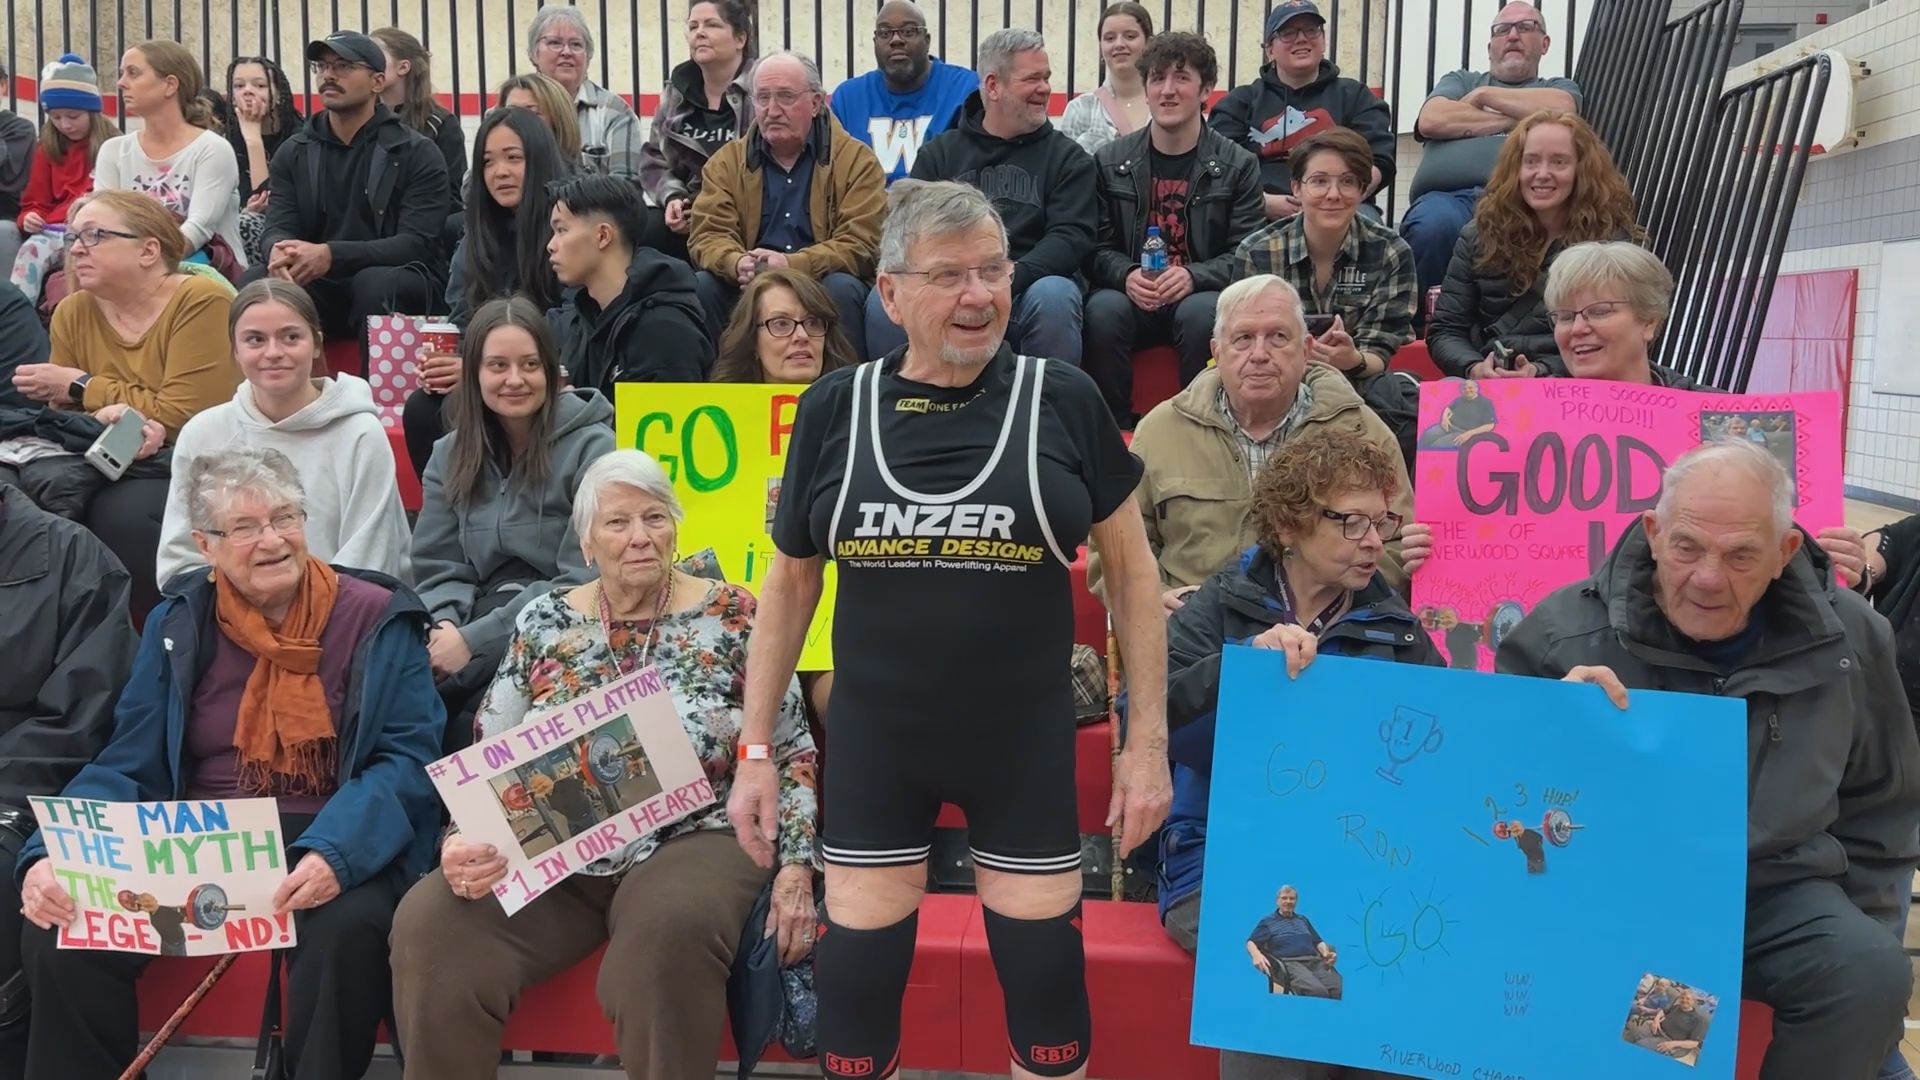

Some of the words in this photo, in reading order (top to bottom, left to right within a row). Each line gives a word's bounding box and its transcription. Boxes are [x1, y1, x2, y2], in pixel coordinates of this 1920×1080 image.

[867, 115, 933, 174] W
[899, 400, 926, 409] TEAM
[929, 402, 950, 412] ONE
[1543, 381, 1591, 399] WE'RE
[1561, 401, 1653, 430] PROUD!!!
[635, 404, 738, 493] GO
[1457, 431, 1667, 516] GOOD
[854, 502, 1016, 540] INZER
[1509, 522, 1537, 540] OF
[837, 538, 932, 557] ADVANCE
[940, 539, 1044, 561] DESIGNS
[848, 560, 861, 569] The
[862, 560, 886, 568] World
[888, 560, 920, 568] Leader
[923, 560, 932, 568] In
[935, 560, 991, 571] Powerlifting
[993, 562, 1027, 572] Apparel
[1528, 543, 1587, 561] SQUARE
[428, 751, 480, 787] #1
[482, 739, 516, 770] ON
[517, 712, 574, 751] THE
[1515, 783, 1529, 808] 3
[30, 797, 113, 832] THE
[136, 801, 230, 835] MAN
[44, 826, 133, 872] THE
[143, 830, 279, 875] MYTH
[494, 869, 541, 902] #1
[534, 851, 570, 886] IN
[575, 822, 627, 863] OUR
[628, 777, 714, 834] HEARTS
[1336, 814, 1412, 870] RON
[55, 868, 124, 913] THE
[829, 1056, 869, 1074] SBD
[1035, 1046, 1076, 1062] SBD
[1380, 1043, 1462, 1076] RIVERWOOD
